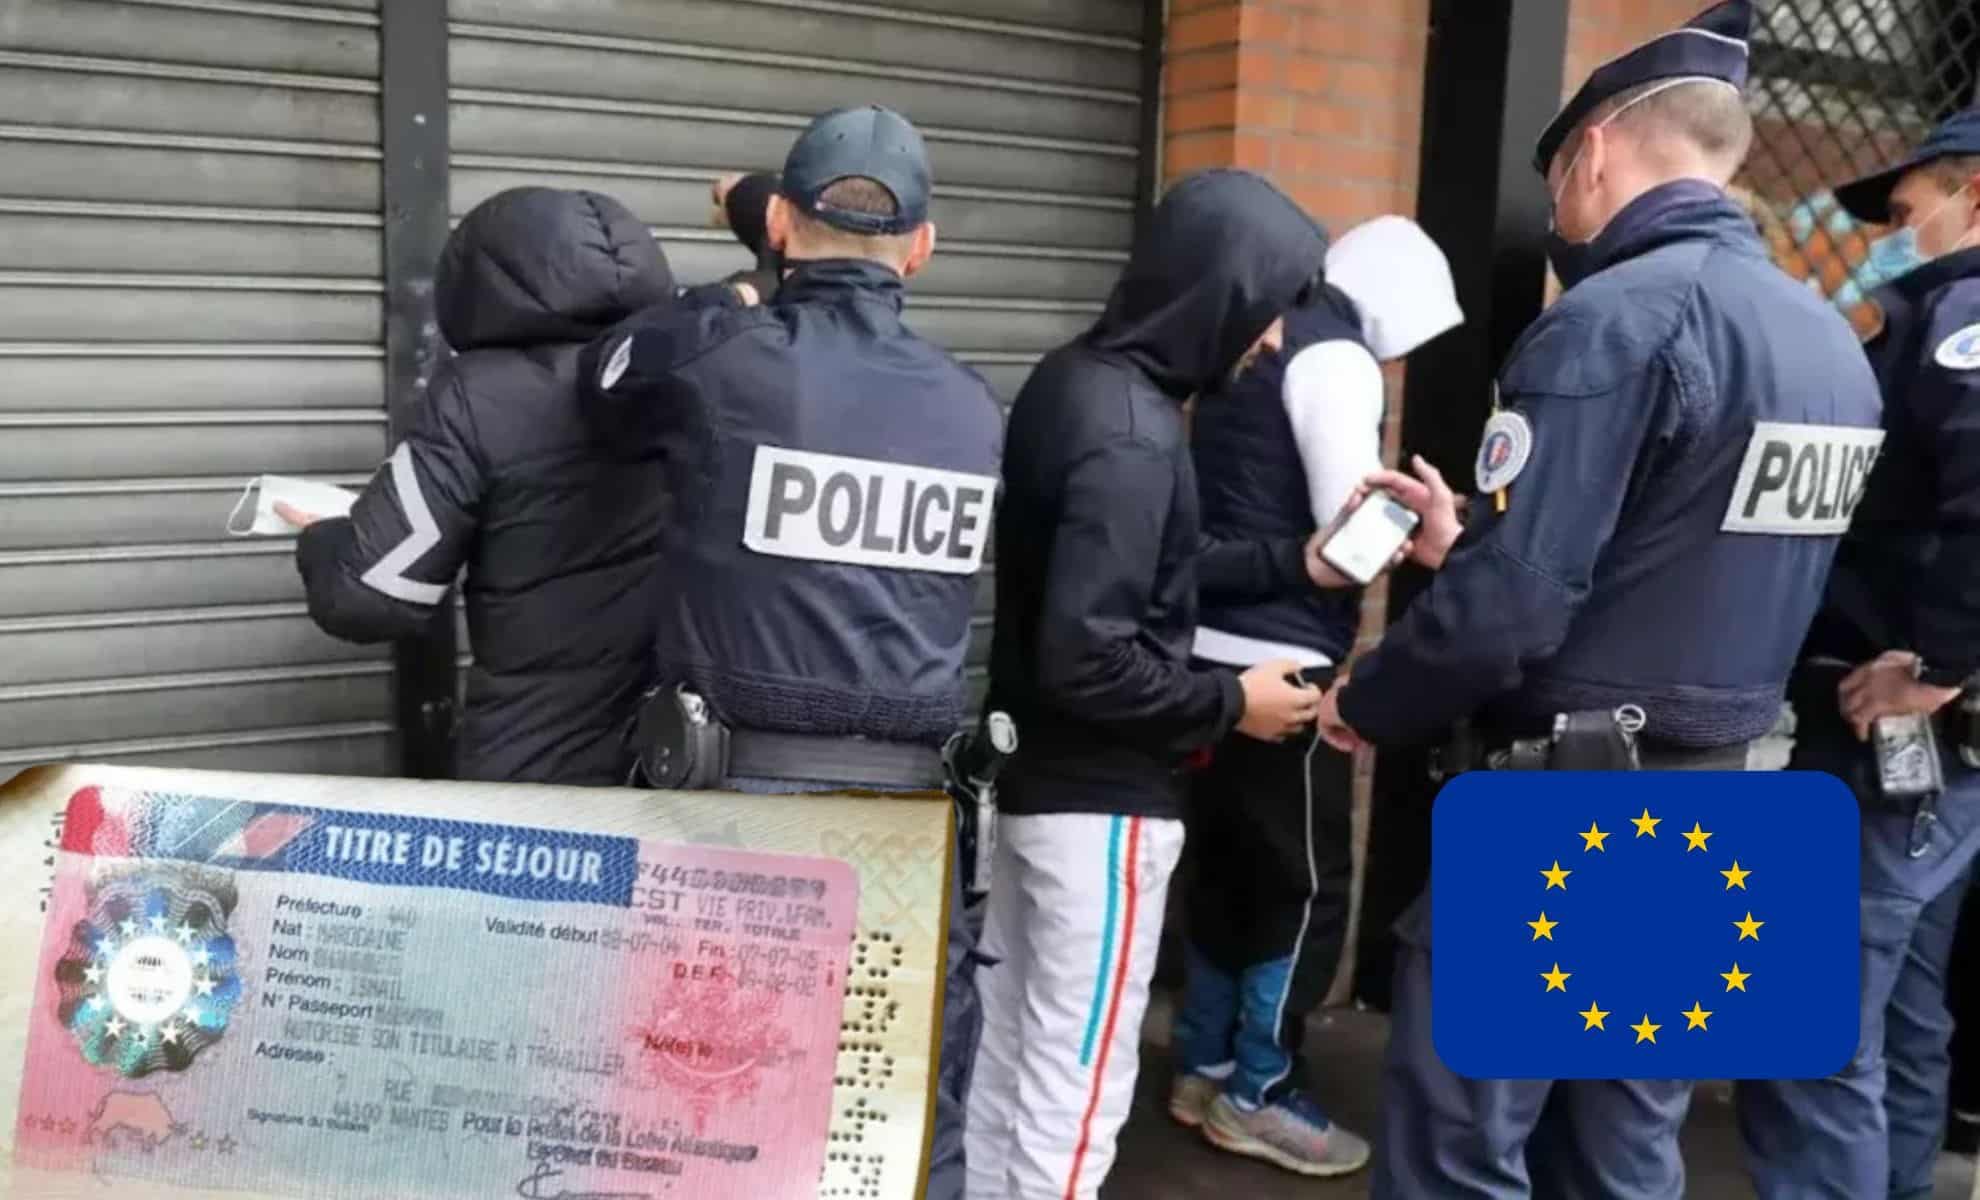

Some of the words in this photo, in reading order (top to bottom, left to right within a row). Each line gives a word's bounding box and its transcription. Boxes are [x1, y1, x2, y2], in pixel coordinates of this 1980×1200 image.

[763, 462, 984, 560] POLICE
[325, 826, 411, 865] TITRE
[421, 835, 465, 871] DE
[475, 832, 603, 884] SÉJOUR
[273, 919, 303, 936] Nat
[550, 924, 599, 944] début
[268, 943, 310, 963] Nom
[266, 966, 331, 990] Prénom
[288, 994, 373, 1018] Passeport
[256, 1041, 325, 1063] Adresse
[463, 1112, 503, 1134] Pour
